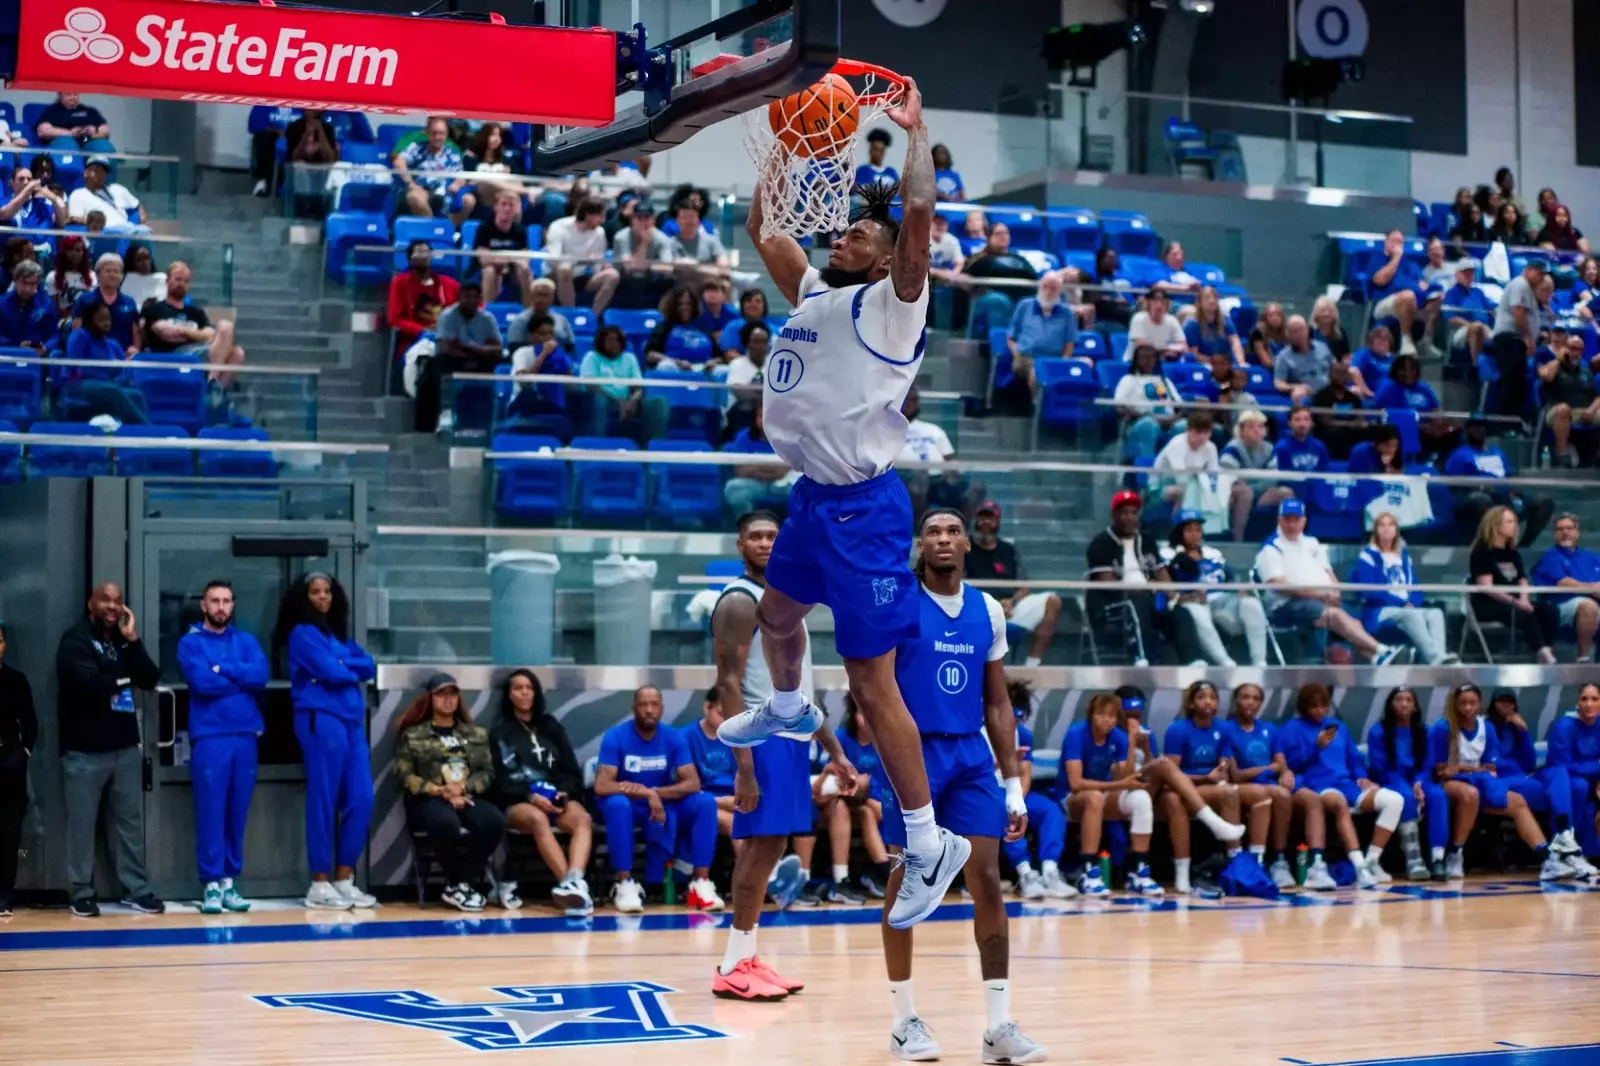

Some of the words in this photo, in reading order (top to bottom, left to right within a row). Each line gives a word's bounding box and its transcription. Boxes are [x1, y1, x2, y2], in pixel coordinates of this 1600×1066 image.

[779, 327, 818, 343] mphis
[776, 358, 793, 384] 11
[933, 640, 975, 655] Memphis
[945, 667, 960, 687] 10
